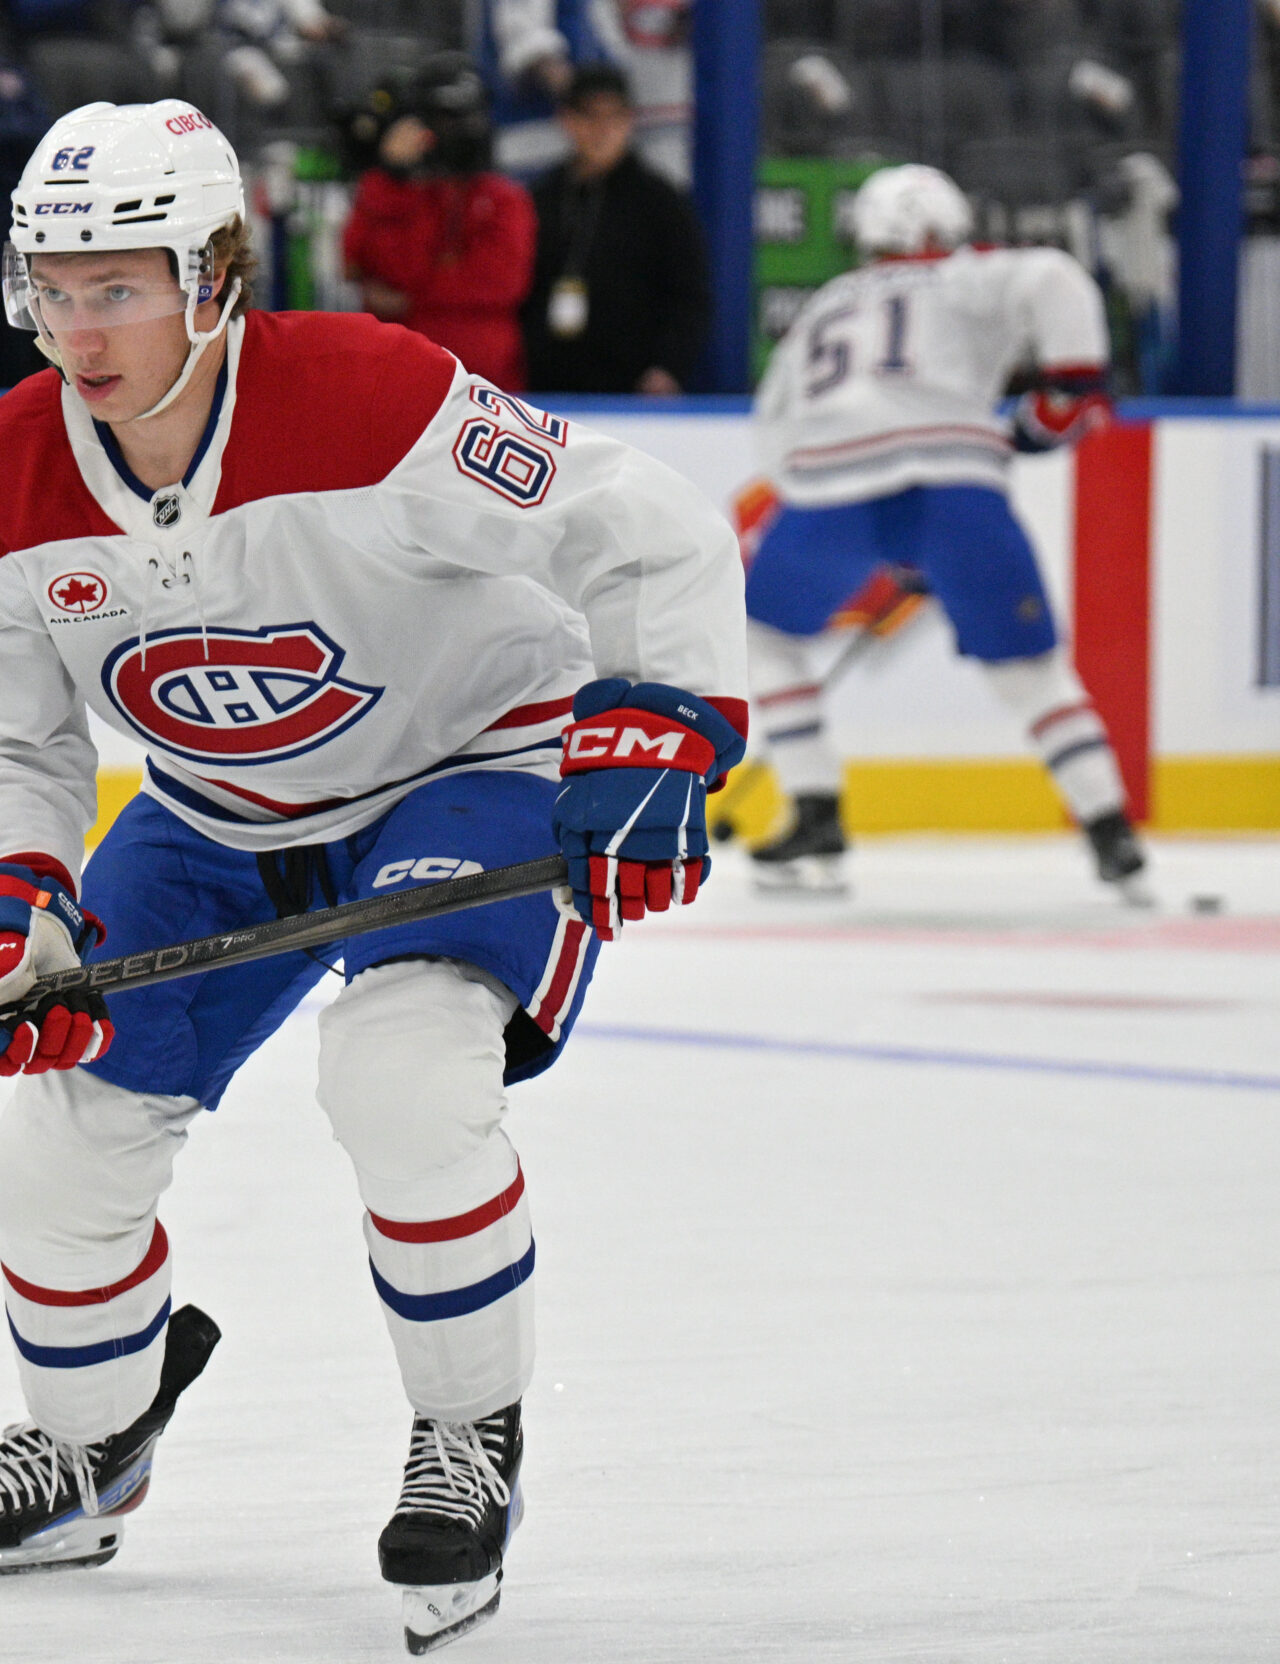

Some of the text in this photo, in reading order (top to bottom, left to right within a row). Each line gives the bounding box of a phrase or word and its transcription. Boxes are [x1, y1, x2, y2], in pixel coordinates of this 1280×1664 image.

[165, 113, 204, 135] CIBC
[51, 146, 96, 171] 62
[34, 202, 94, 215] CCM
[806, 297, 917, 402] 51
[452, 385, 568, 509] 62
[73, 608, 128, 623] CANADA
[677, 705, 699, 721] BECK
[561, 727, 686, 761] CM
[57, 892, 83, 923] CCM
